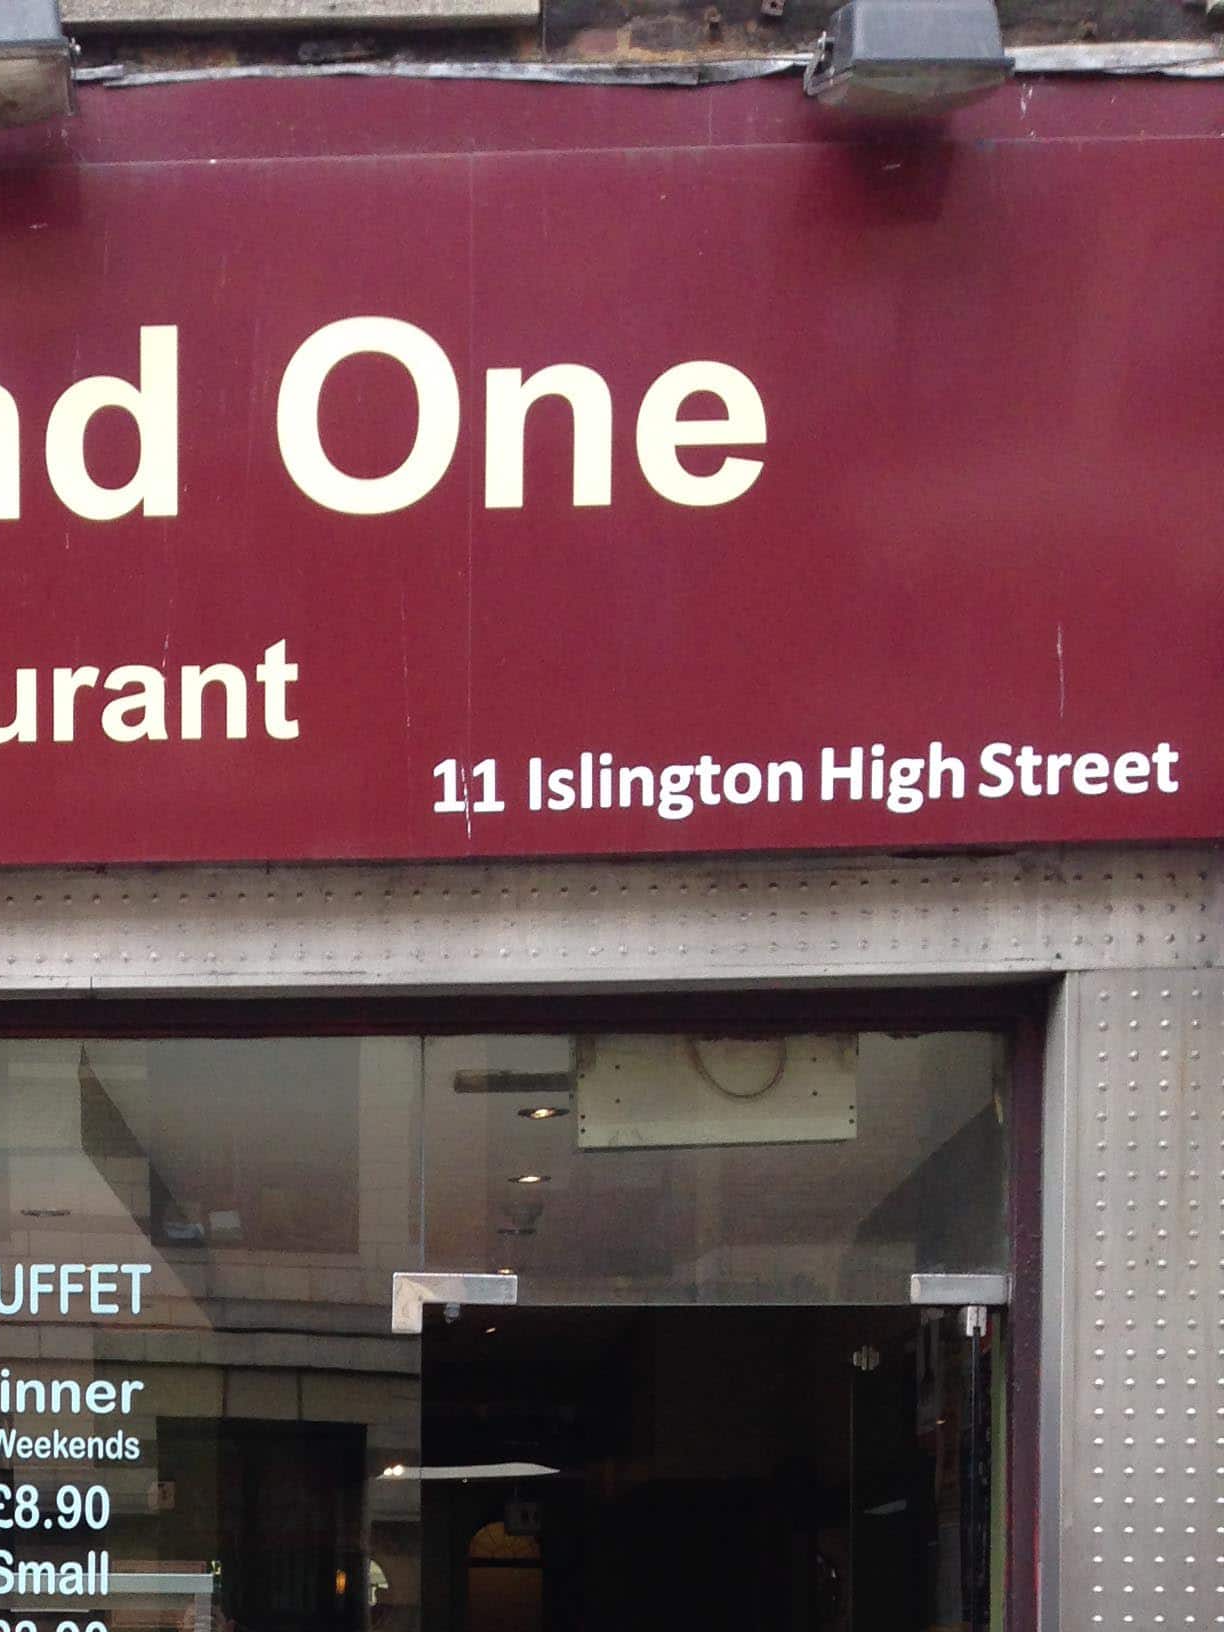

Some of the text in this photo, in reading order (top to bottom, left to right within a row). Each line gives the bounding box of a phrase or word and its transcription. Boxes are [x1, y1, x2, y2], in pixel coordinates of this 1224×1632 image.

[274, 314, 769, 516] One
[431, 741, 1180, 820] 11 Islington High Street
